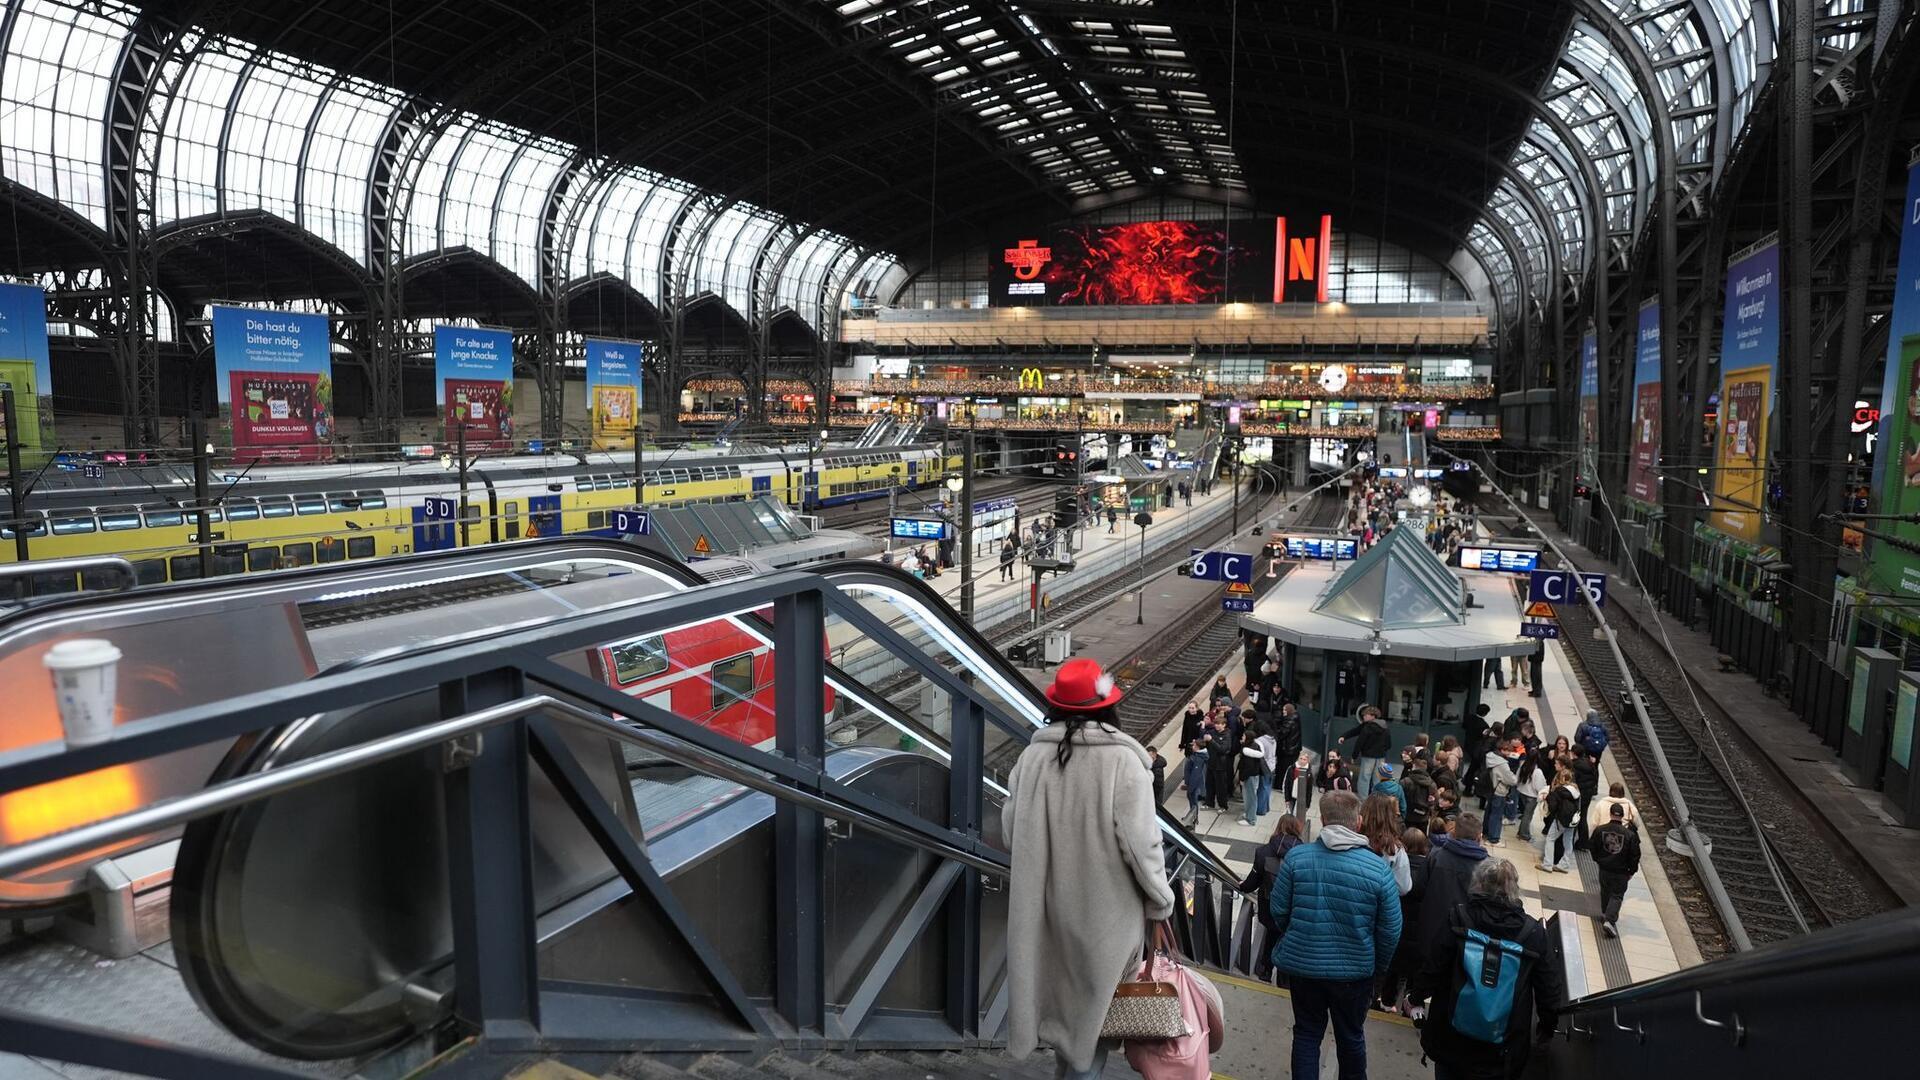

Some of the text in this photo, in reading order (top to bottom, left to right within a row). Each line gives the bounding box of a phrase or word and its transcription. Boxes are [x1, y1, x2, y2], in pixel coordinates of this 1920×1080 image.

[246, 320, 300, 334] Die hast du
[247, 332, 301, 349] bitter nötig.
[456, 338, 494, 350] Für alte und
[471, 350, 499, 360] Knacker.
[86, 467, 93, 477] 11
[426, 501, 448, 517] 8 D
[1861, 499, 1867, 507] 3
[618, 514, 646, 531] D 7
[1194, 554, 1239, 579] 6 C
[1544, 576, 1602, 602] C 5
